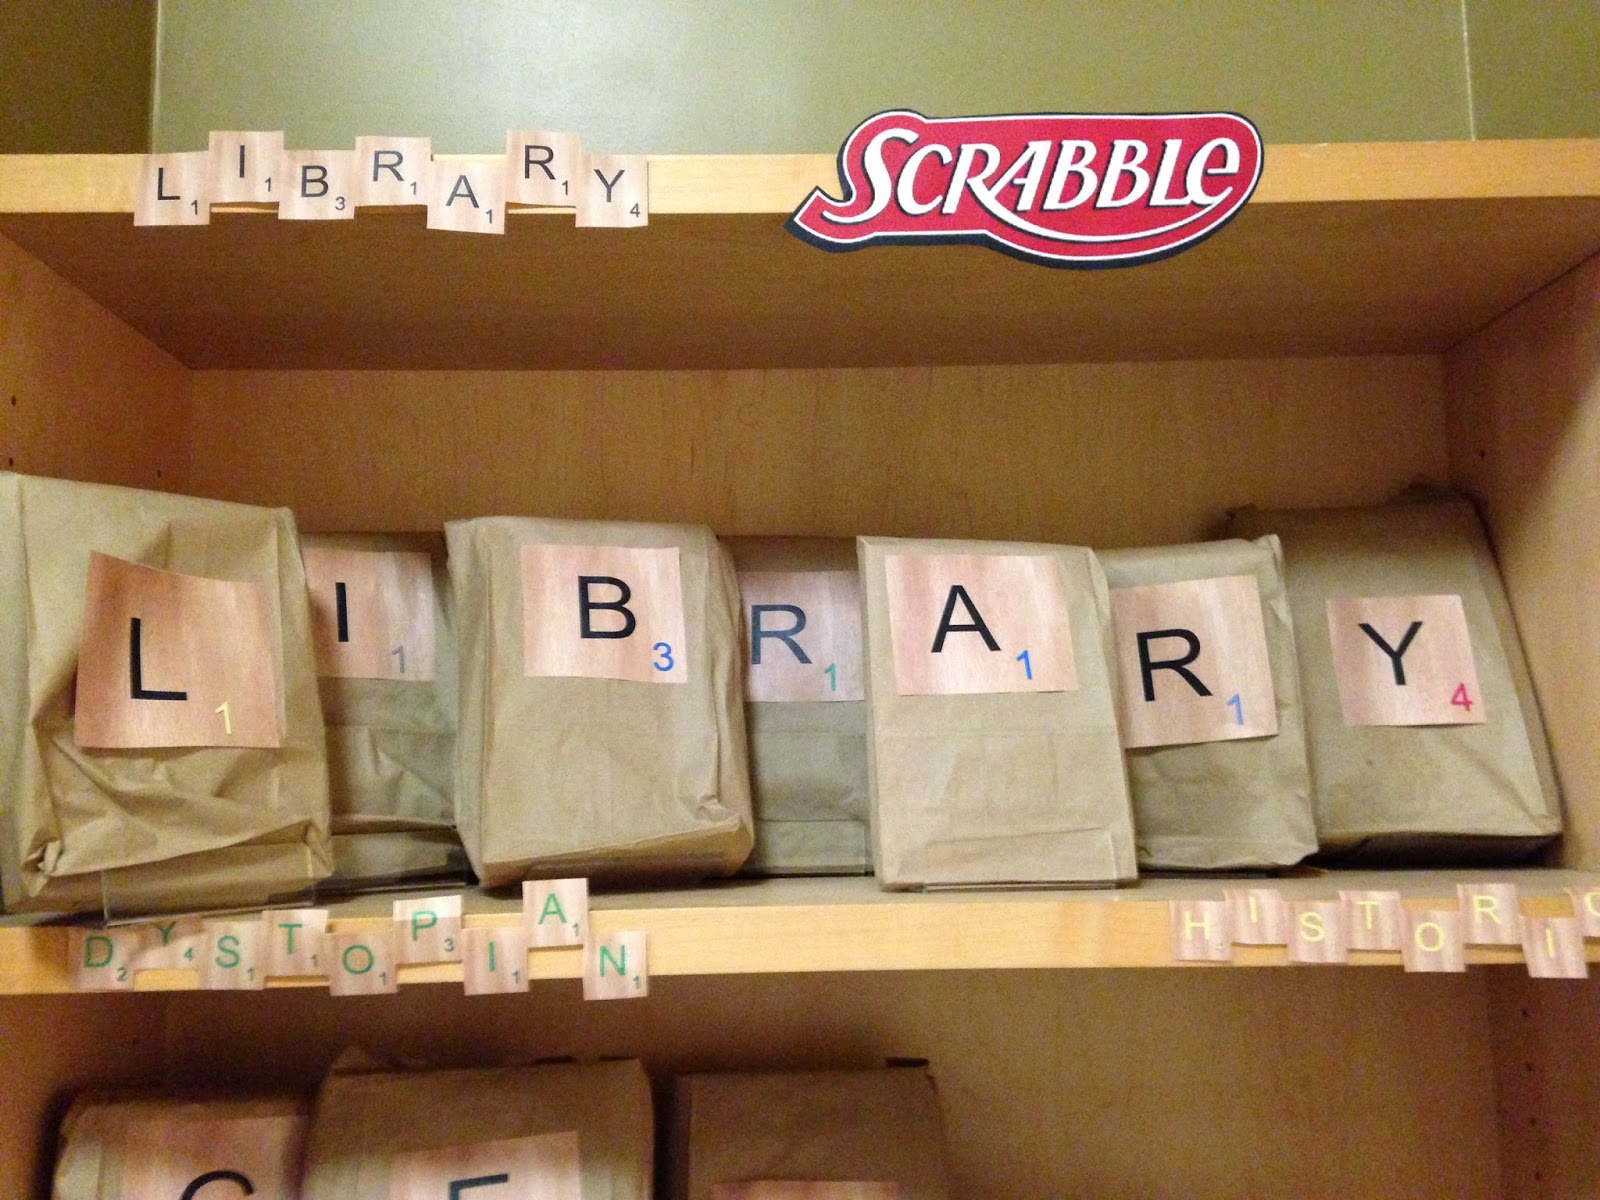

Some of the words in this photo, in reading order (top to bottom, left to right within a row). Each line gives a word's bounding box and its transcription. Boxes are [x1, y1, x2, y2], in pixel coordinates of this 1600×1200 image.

[334, 581, 349, 643] I
[390, 645, 405, 674] 1
[576, 575, 638, 640] B
[652, 641, 675, 672] 3
[749, 603, 813, 665] R
[823, 661, 838, 692] 1
[930, 583, 1002, 654] A
[1015, 649, 1033, 680] 1
[1357, 620, 1425, 687] Y
[1450, 683, 1474, 712] 4
[129, 616, 188, 701] L
[214, 701, 233, 736] 1
[1135, 627, 1214, 702] R
[1224, 693, 1245, 726] 1
